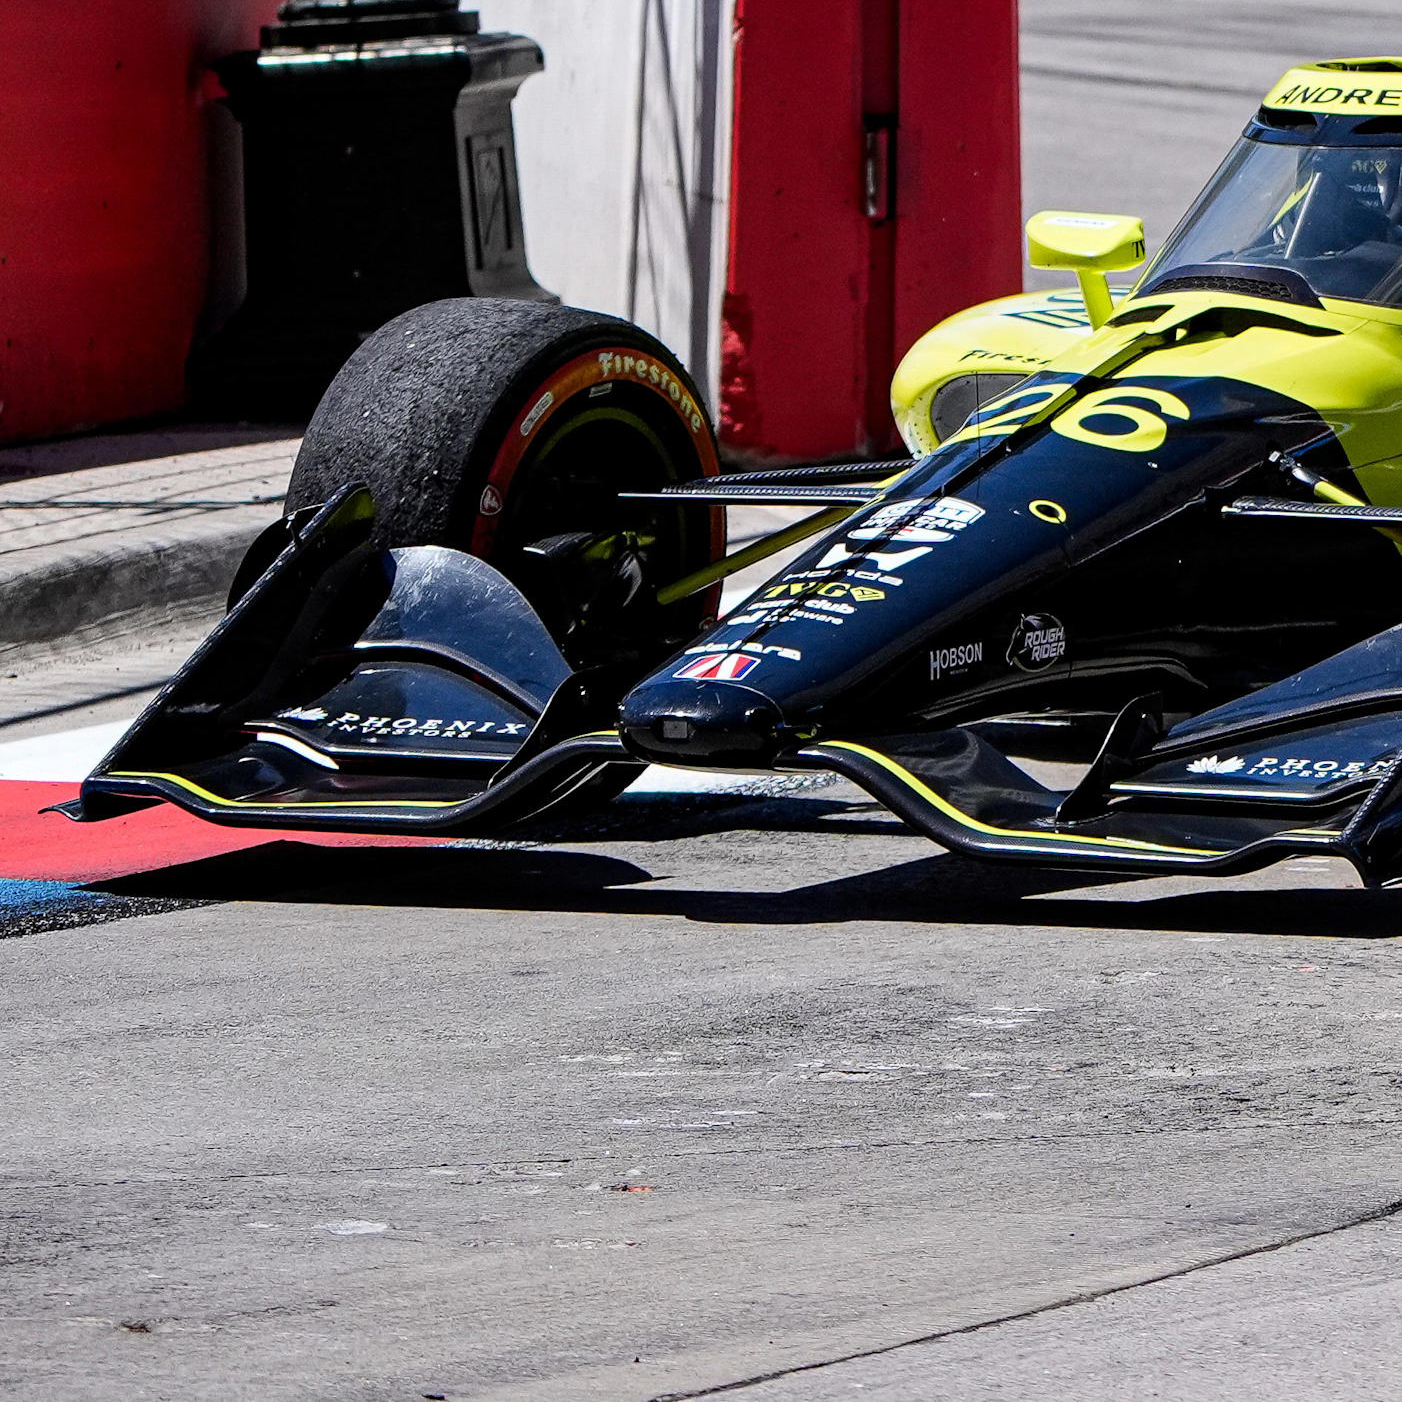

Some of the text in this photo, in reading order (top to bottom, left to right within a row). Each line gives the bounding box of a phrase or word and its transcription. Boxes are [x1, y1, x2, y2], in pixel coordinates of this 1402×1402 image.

[598, 352, 702, 434] Firestone
[935, 382, 1191, 453] 26
[1024, 627, 1065, 648] ROUGH
[929, 641, 983, 681] HOBSON
[1031, 641, 1066, 662] RIDER
[326, 721, 473, 739] INVESTORS
[334, 712, 526, 735] PHOENIX
[1254, 757, 1396, 773] PHOEN
